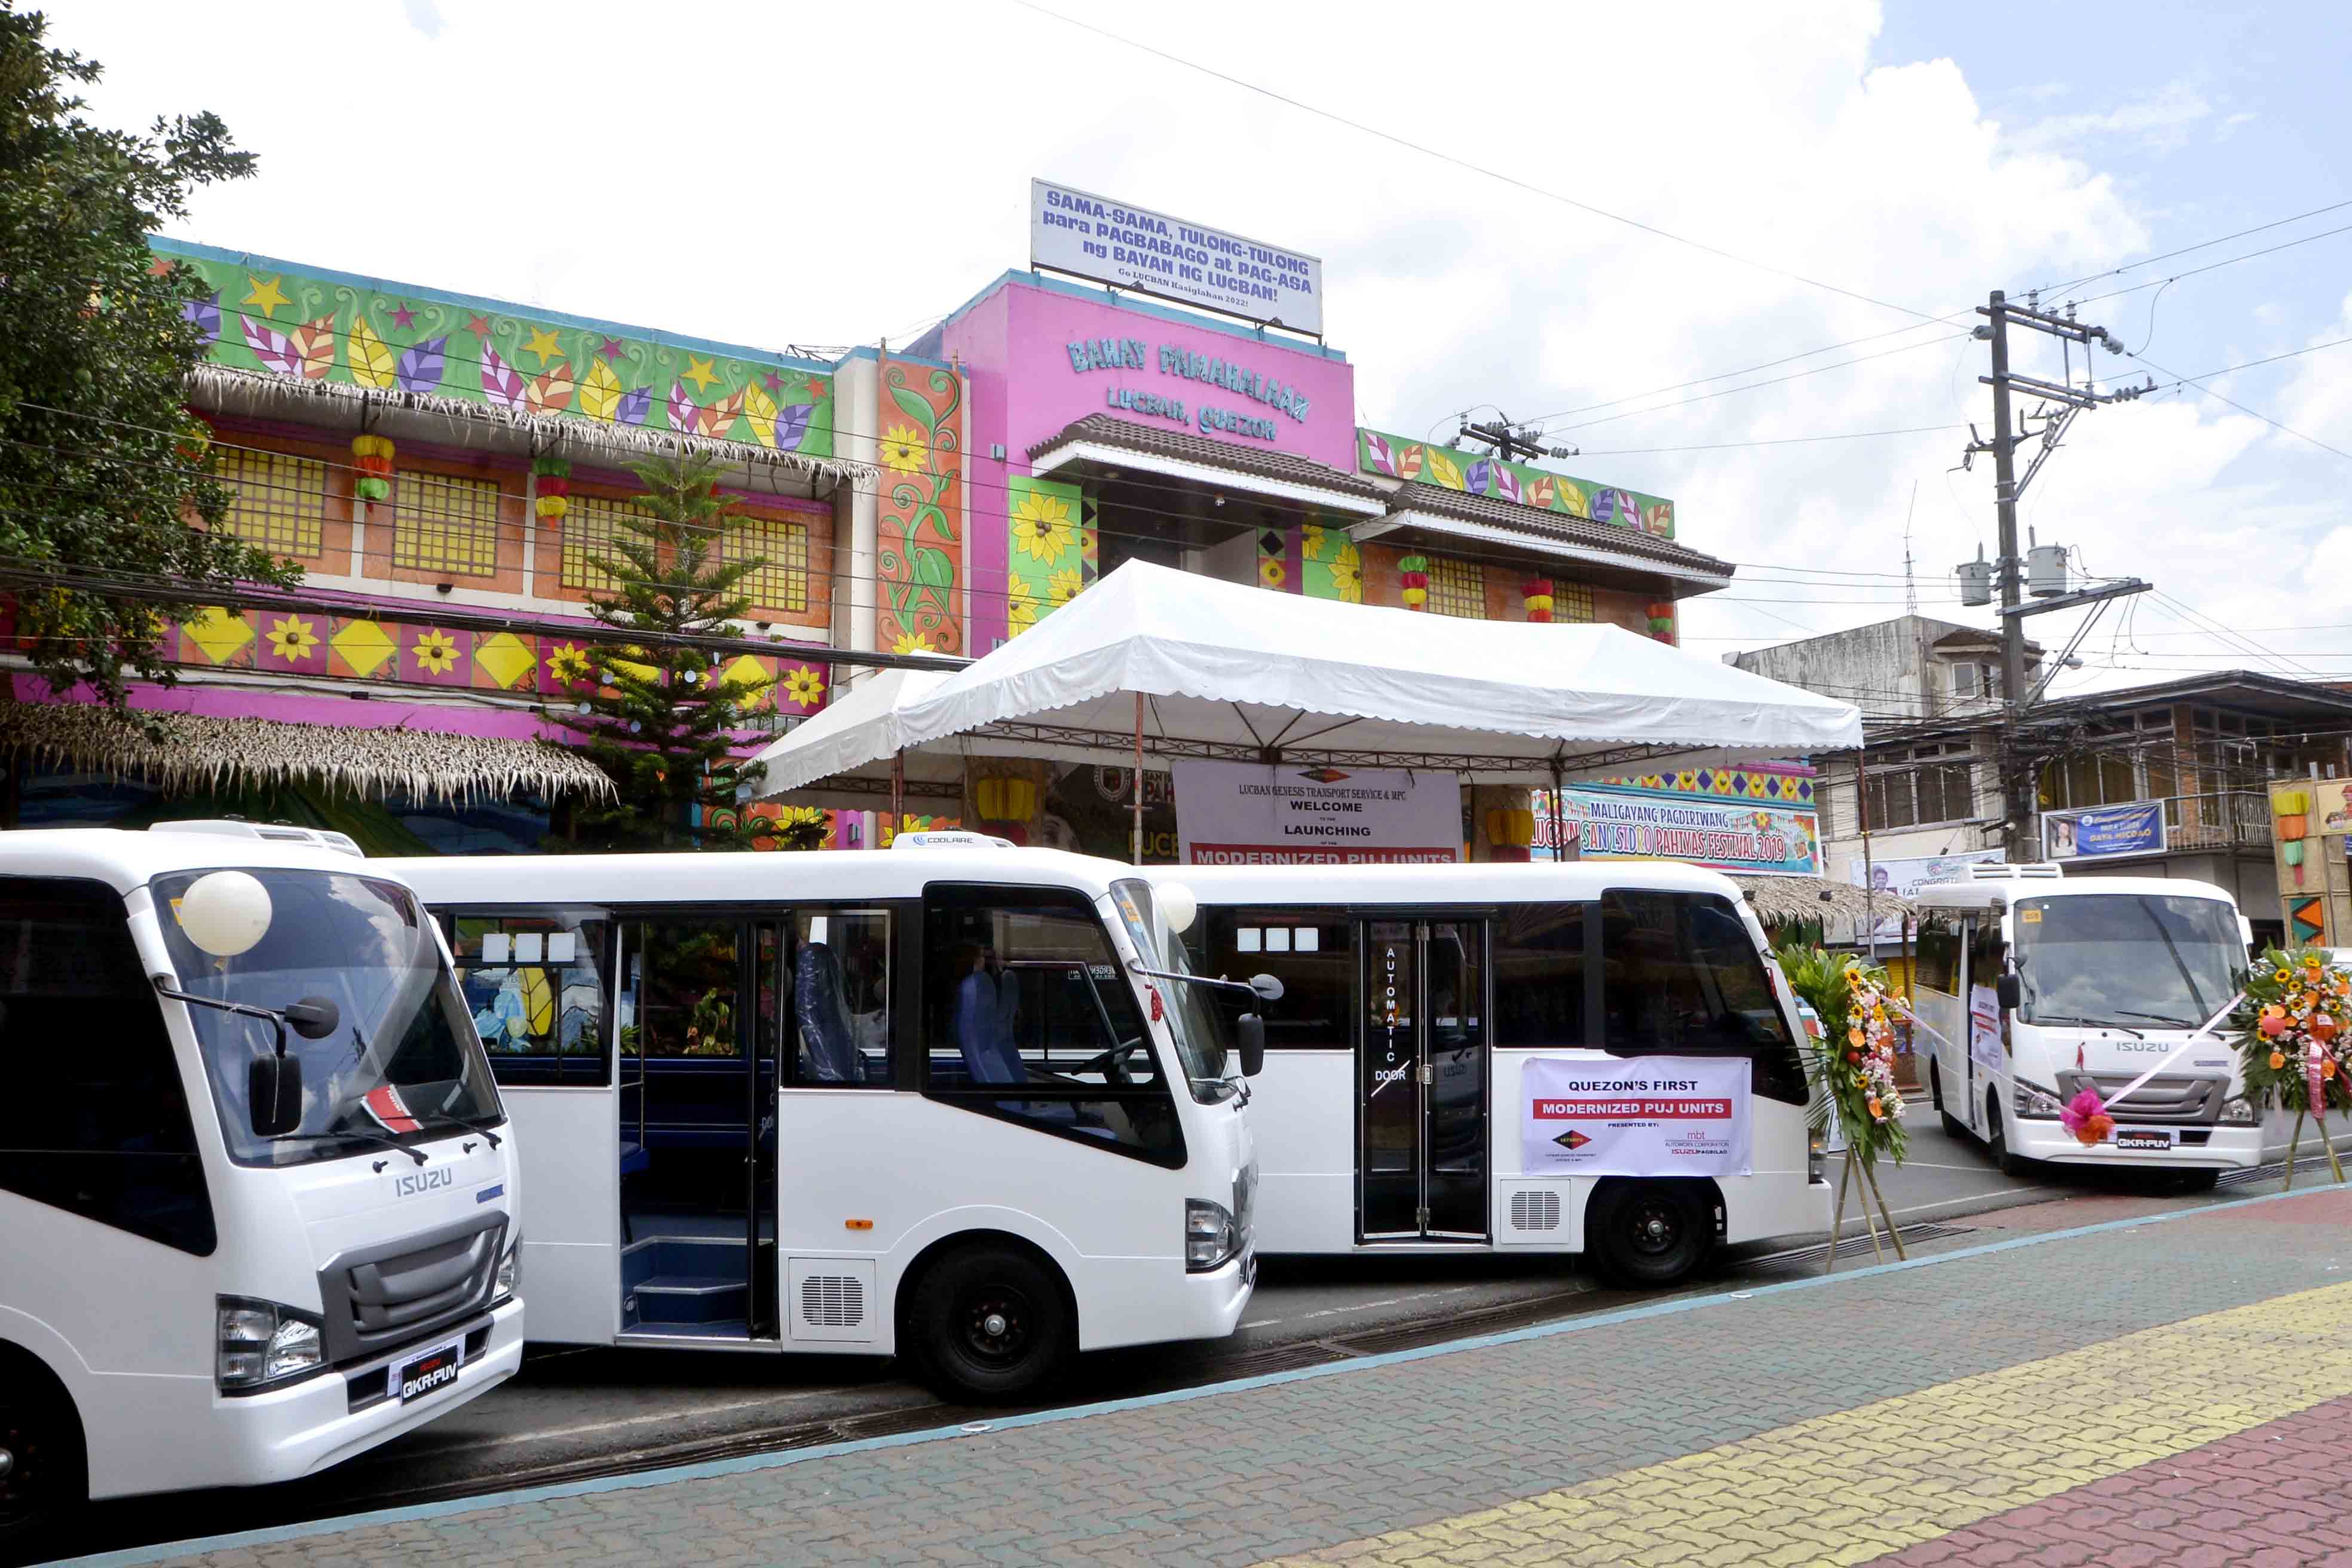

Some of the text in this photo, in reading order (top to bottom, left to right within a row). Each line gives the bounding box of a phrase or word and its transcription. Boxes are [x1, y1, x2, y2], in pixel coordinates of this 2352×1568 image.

[1047, 191, 1309, 275] SAMA-SAMA, TULONG-TULONG
[1043, 210, 1312, 294] para PAGBABAGO at PAG-ASA
[1083, 240, 1278, 302] ng BAYAN NG LUCBAN!
[1132, 272, 1169, 288] LUCBAN
[1067, 338, 1311, 424] BAHAY PAMAHALAAN
[1199, 406, 1276, 441] QUEZON
[1239, 784, 1406, 801] LUCBAN GENESIS TRANSPORT SERVICE & MPC
[1290, 801, 1363, 812] WELCOME
[1591, 803, 1729, 828] MALIGAYANG PAGDIRIWANG
[1285, 825, 1371, 837] LAUNCHING
[1582, 821, 1608, 850] SAN
[1610, 824, 1653, 854] ISIDRO
[1655, 827, 1705, 856] PAHIYAS
[1707, 832, 1757, 860] FESTIVAL
[1758, 835, 1786, 861] 2019
[1196, 850, 1340, 865] MODERNIZED
[2117, 1042, 2169, 1052] ISUZU
[1375, 1070, 1406, 1081] DOOR
[1569, 1080, 1698, 1091] QUEZON'S FIRST
[1542, 1103, 1725, 1114] MODERNIZED PUJ UNITS
[396, 1167, 452, 1198] ISUZU
